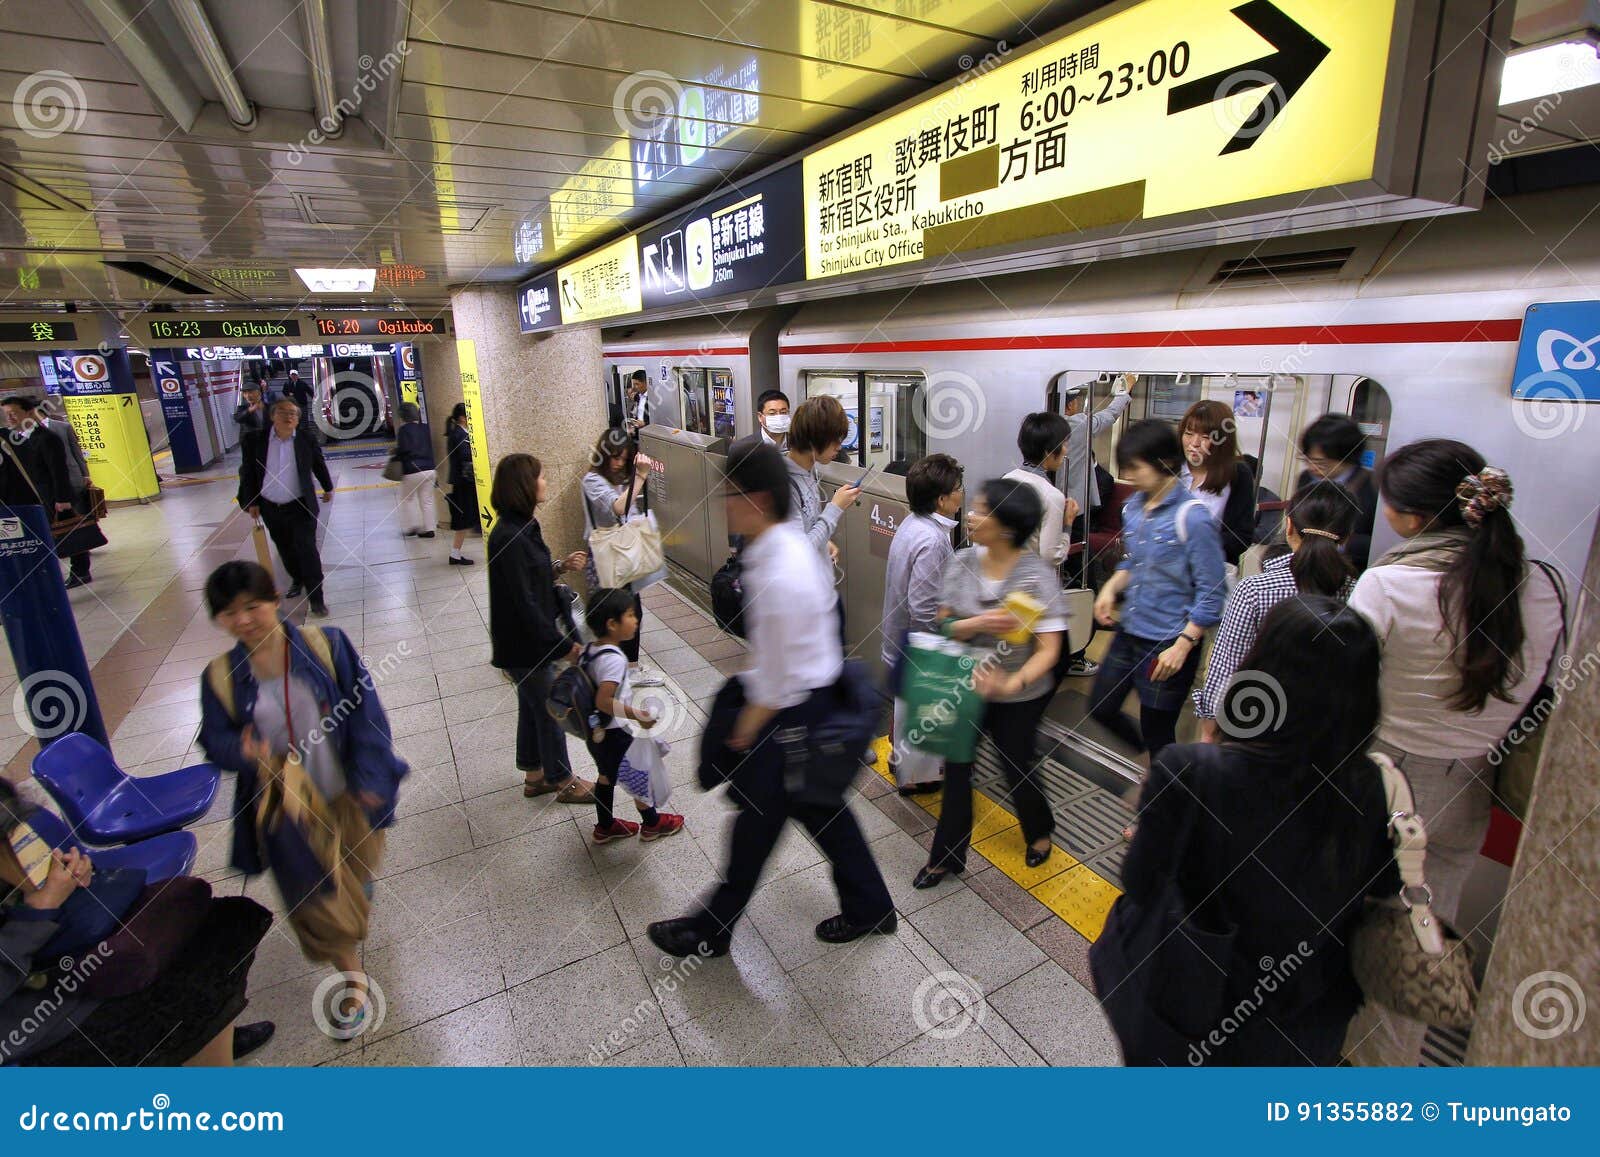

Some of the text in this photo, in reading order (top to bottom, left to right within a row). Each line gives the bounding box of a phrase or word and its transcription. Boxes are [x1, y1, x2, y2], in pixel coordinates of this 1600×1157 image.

[1021, 43, 1100, 97] 利用時間
[818, 103, 1000, 202] 新宿駅 歌舞伎町
[1000, 122, 1069, 184] 方面
[721, 203, 765, 248] 新宿線
[819, 174, 917, 236] 新宿区役所
[820, 200, 984, 253] for Shinjuku Sta., Kabukicho
[713, 240, 764, 266] Shinjuku Line
[714, 268, 734, 282] 260m
[820, 240, 924, 274] Shinjuku City Office
[152, 321, 286, 338] 16:23 Ogikubo
[318, 319, 433, 336] 16:20 Ogikubo
